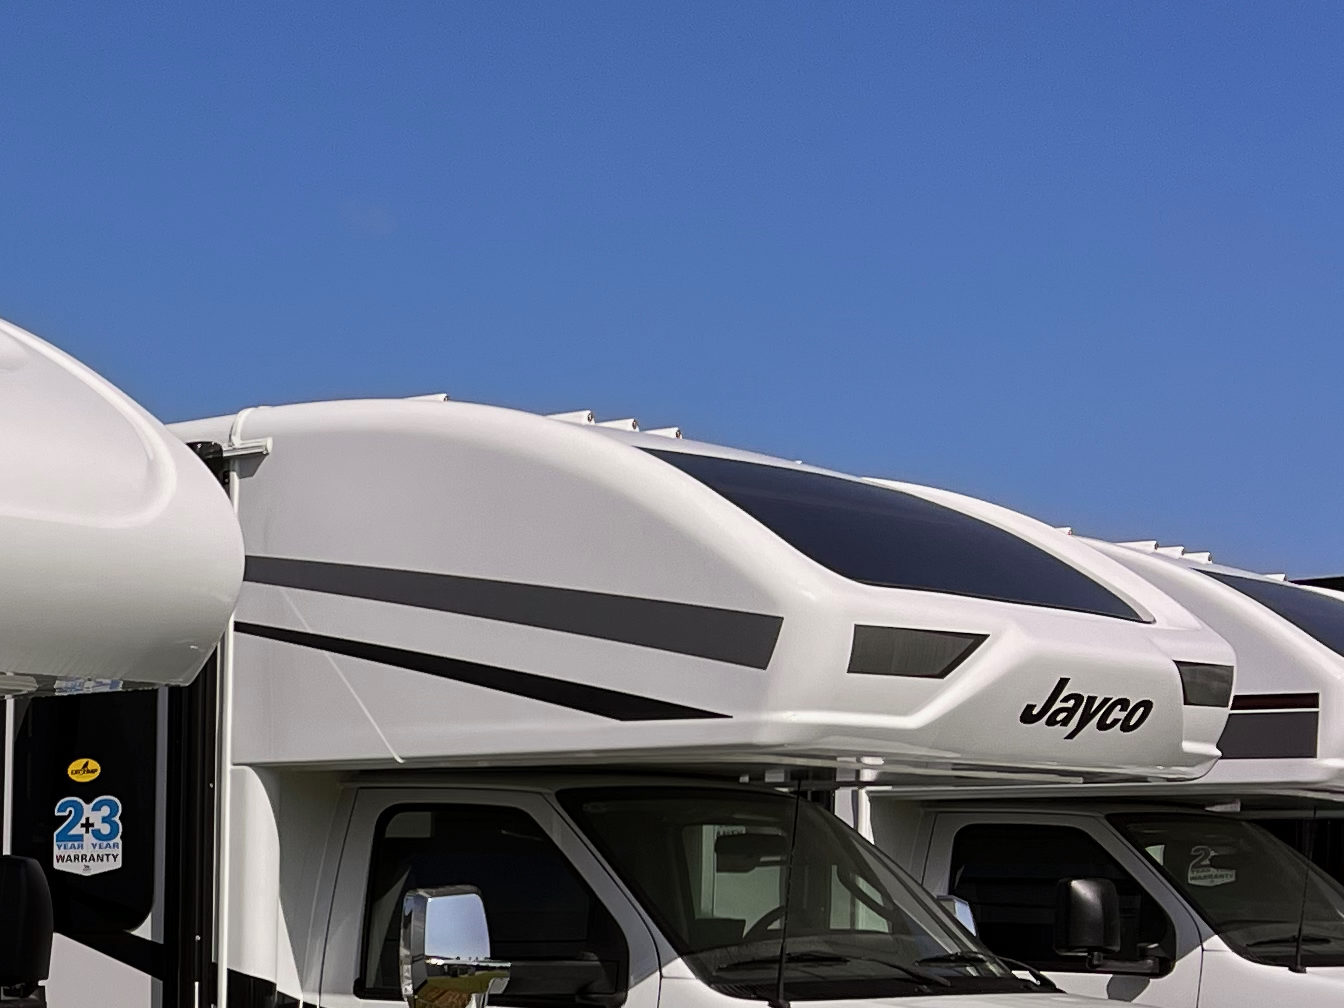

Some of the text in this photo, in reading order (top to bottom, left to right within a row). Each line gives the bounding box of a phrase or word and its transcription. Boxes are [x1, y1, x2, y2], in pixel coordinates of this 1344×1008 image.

[1019, 677, 1154, 740] Jayco
[56, 841, 120, 851] YEAR YEAR
[55, 853, 120, 864] WARRANTY
